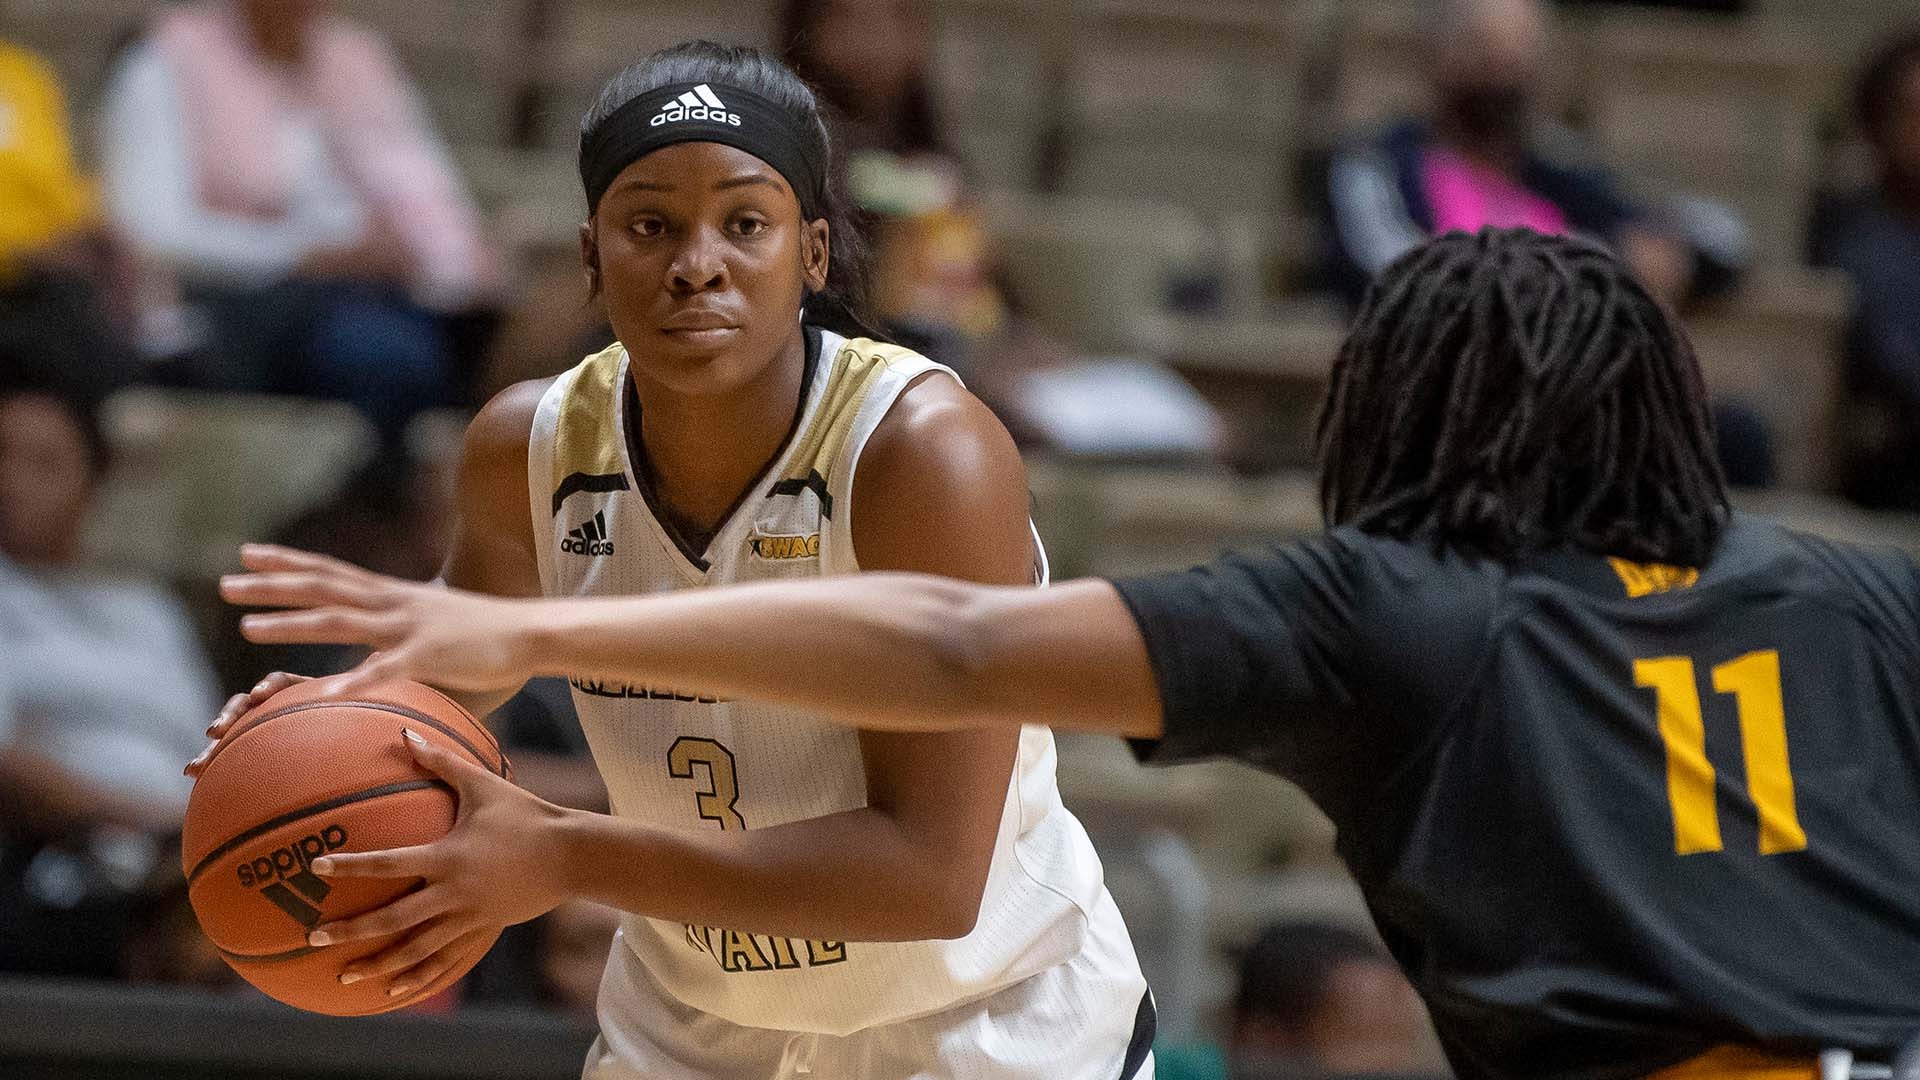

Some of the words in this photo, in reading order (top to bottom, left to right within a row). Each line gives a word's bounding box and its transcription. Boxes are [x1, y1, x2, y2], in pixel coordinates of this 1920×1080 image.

[650, 105, 741, 127] adidas
[561, 538, 614, 556] adidas
[666, 735, 746, 831] 3
[1632, 648, 1808, 856] 11
[237, 824, 348, 888] adidas
